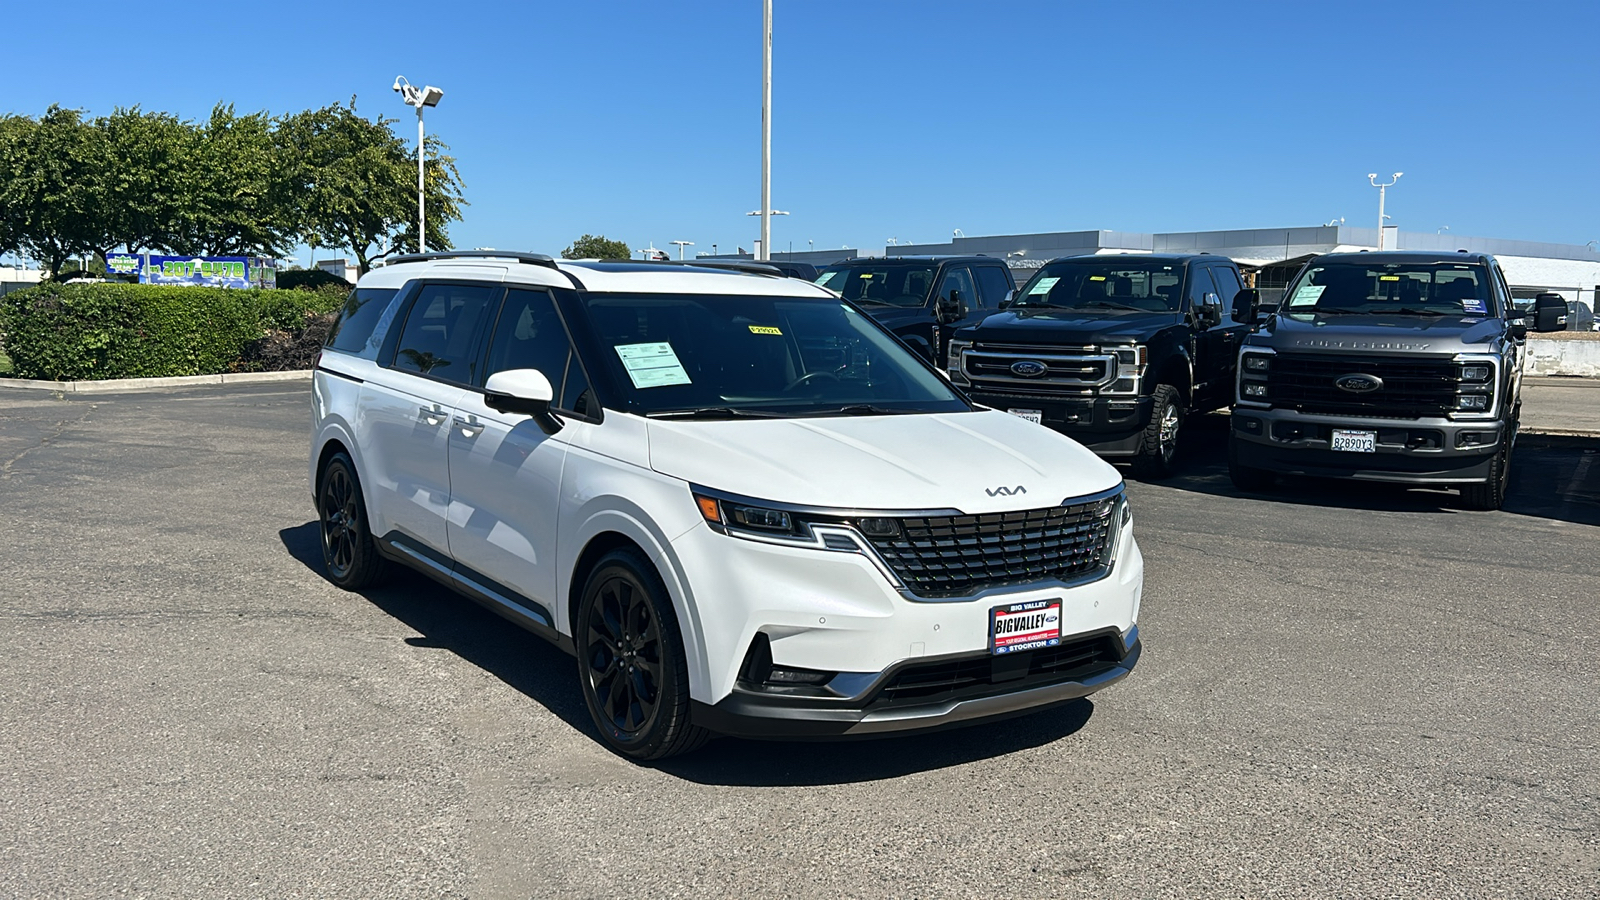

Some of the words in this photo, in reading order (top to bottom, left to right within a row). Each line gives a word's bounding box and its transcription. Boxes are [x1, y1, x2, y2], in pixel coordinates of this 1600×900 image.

[1334, 437, 1373, 450] 82890Y3
[1010, 604, 1023, 612] BIG
[1023, 601, 1047, 610] VALLEY
[996, 613, 1047, 635] BIGVALLEY
[1009, 640, 1047, 652] STOCKTON
